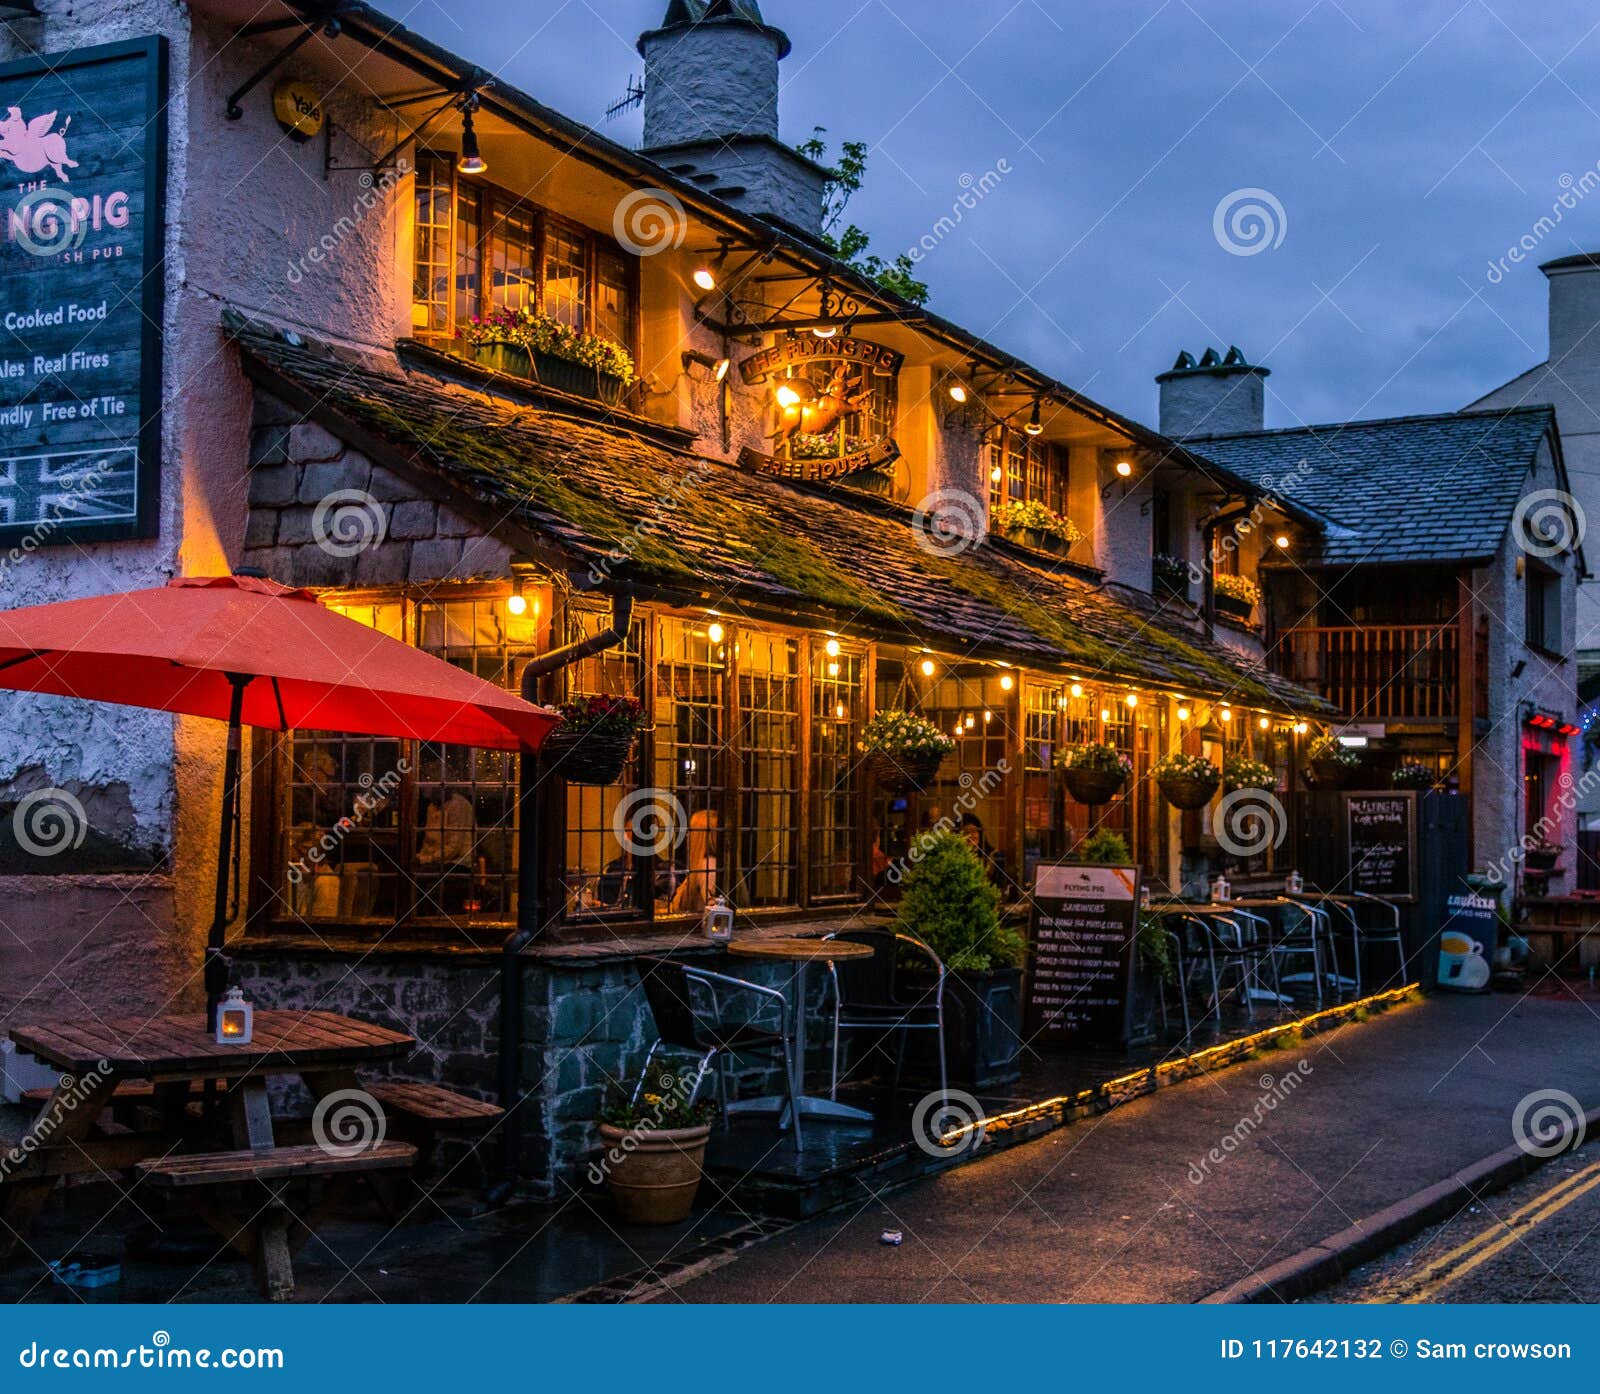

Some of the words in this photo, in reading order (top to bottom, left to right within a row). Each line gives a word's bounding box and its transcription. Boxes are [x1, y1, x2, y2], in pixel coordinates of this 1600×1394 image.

[291, 92, 321, 121] Yale
[18, 180, 48, 194] THE
[0, 202, 60, 241] NG
[71, 191, 130, 234] PIG
[92, 246, 123, 260] PUB
[5, 306, 63, 330] Cooked
[68, 300, 107, 323] Food
[33, 353, 67, 375] Real
[71, 351, 109, 371] Fires
[745, 346, 782, 375] THE
[786, 338, 856, 359] FLYING
[861, 344, 894, 368] PIG
[42, 402, 77, 421] Free
[80, 398, 98, 417] of
[101, 396, 125, 415] Tie
[760, 459, 803, 478] FREE
[808, 452, 871, 479] HOUSE
[1064, 884, 1090, 892] FLYING
[1092, 885, 1105, 893] PIG
